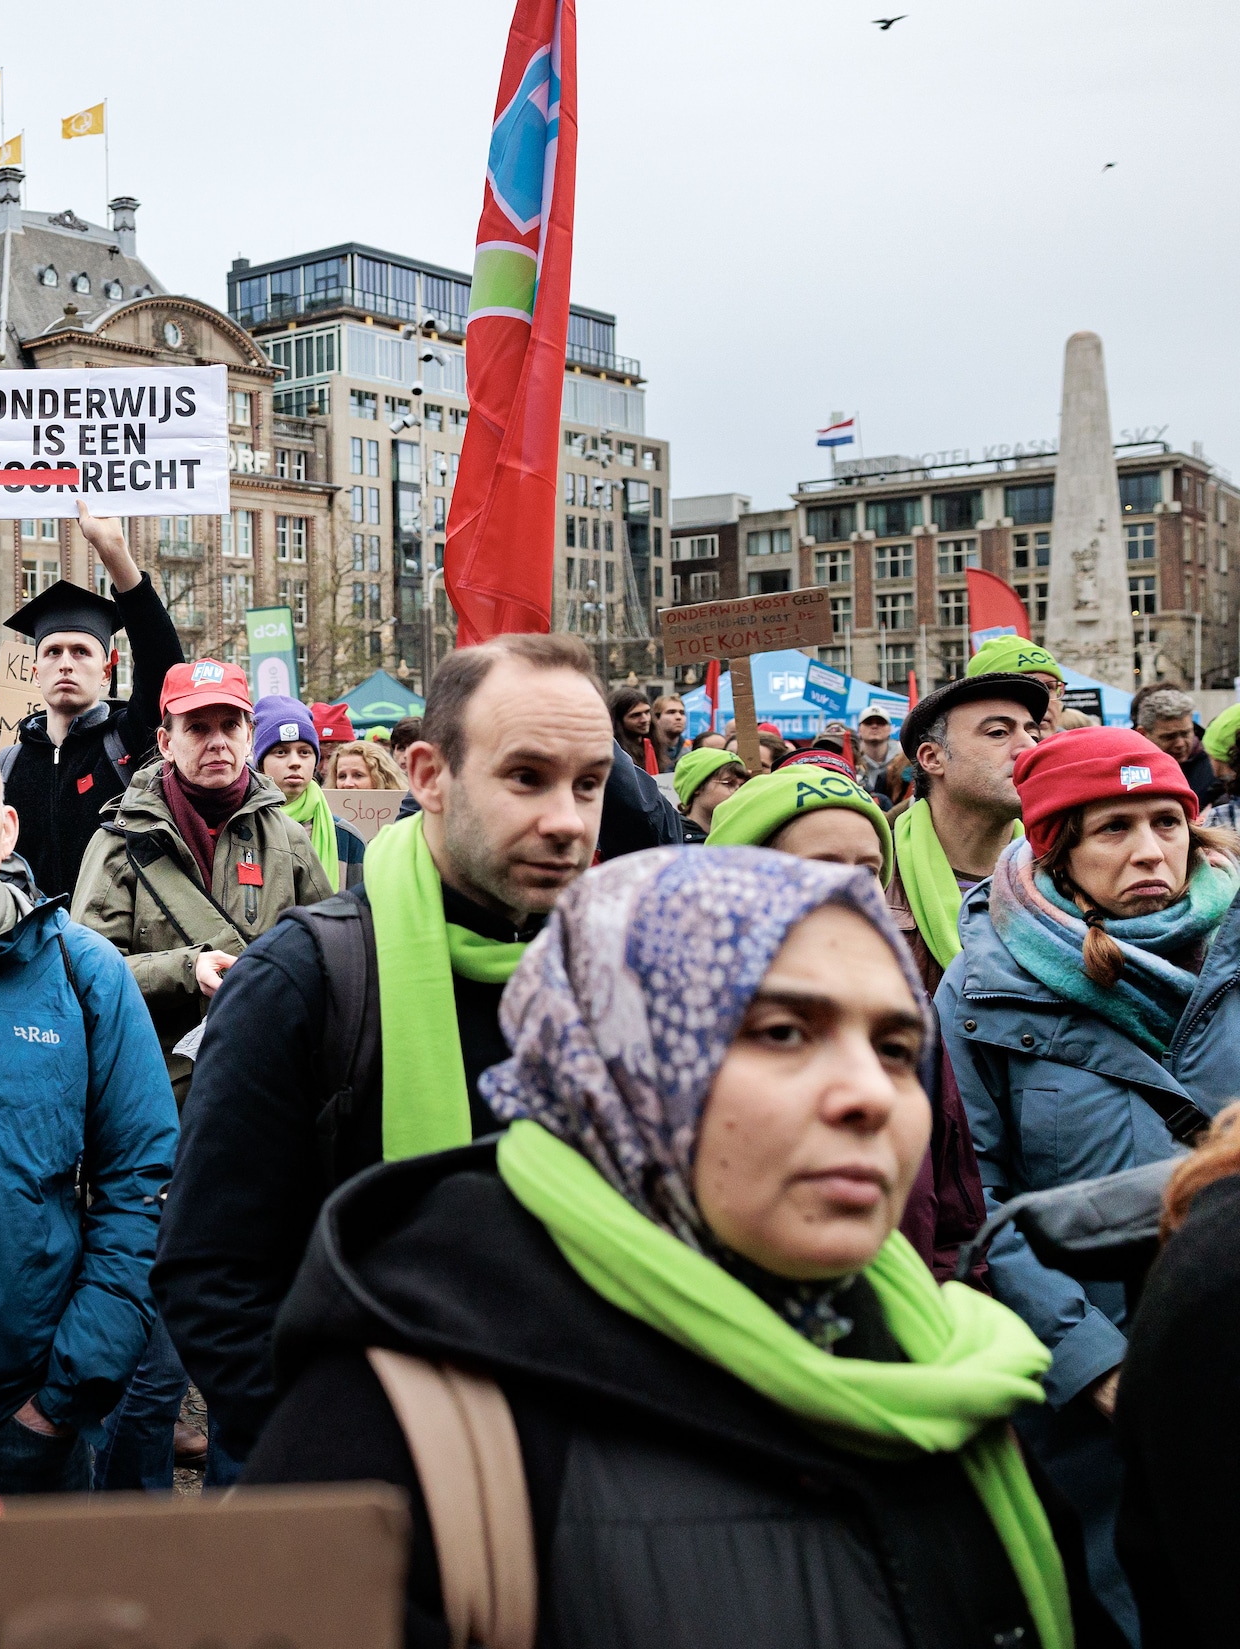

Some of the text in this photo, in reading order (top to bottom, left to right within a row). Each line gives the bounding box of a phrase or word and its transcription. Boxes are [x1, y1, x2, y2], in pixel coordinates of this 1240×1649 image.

[33, 423, 147, 456] IS EEN
[666, 592, 825, 624] ONDERWIJS KOST GELD
[762, 613, 791, 624] KOST
[772, 675, 807, 691] FN
[1121, 768, 1151, 783] FNV
[342, 798, 391, 831] Stop
[27, 1026, 60, 1045] Rab
